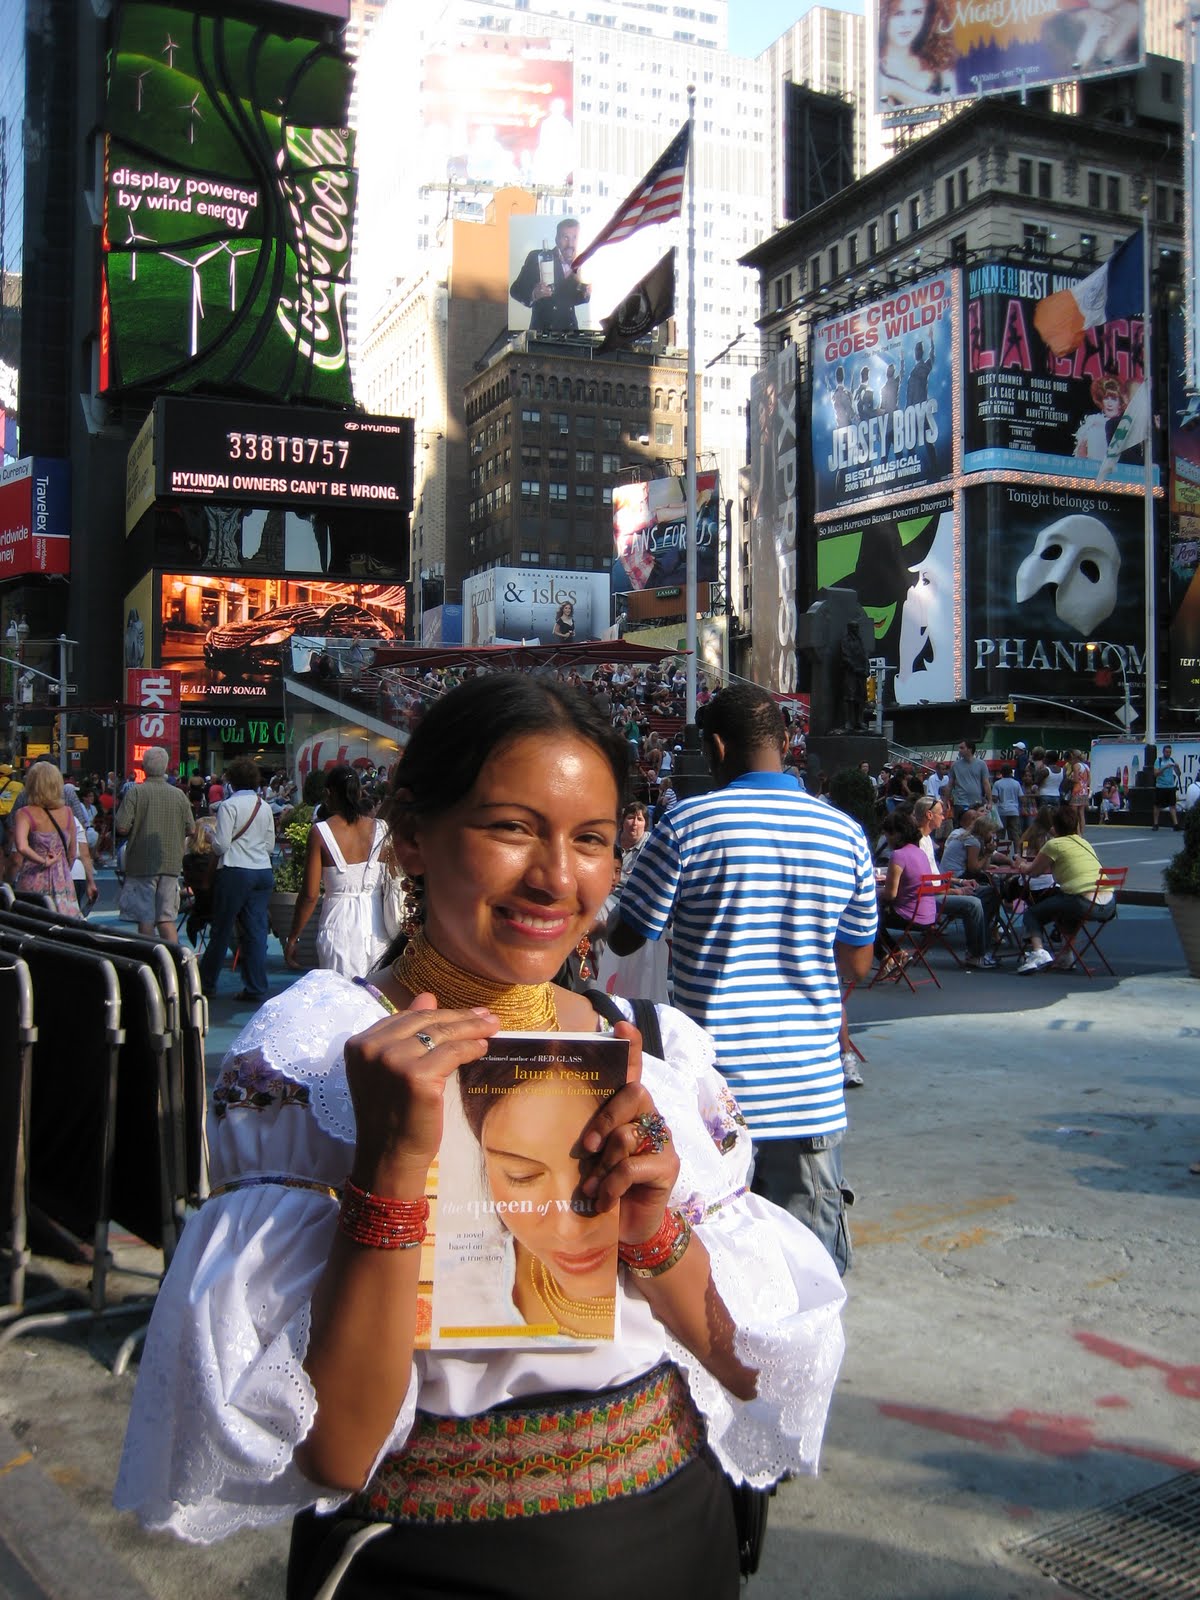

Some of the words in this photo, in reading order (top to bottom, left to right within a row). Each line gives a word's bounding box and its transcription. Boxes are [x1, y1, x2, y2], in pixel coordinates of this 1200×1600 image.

[112, 168, 181, 194] display
[186, 179, 258, 208] powered
[118, 189, 142, 212] by
[146, 194, 192, 213] wind
[196, 201, 249, 231] energy
[969, 265, 1018, 292] WINNER!
[1019, 269, 1048, 299] BEST
[866, 280, 945, 327] CROWD
[824, 327, 879, 363] GOES
[968, 300, 1032, 374] LA
[989, 386, 998, 398] LA
[1000, 386, 1015, 400] CAGE
[1017, 389, 1029, 402] AUX
[1031, 391, 1053, 405] FOLLES
[361, 424, 400, 434] HYUNDAI
[828, 413, 889, 472] JERSEY
[893, 399, 938, 454] BOYS
[229, 434, 349, 469] 33819757
[2, 463, 29, 480] Currency
[844, 467, 871, 483] BEST
[873, 454, 921, 476] MUSICAL
[859, 477, 874, 489] TONY
[897, 464, 921, 478] WINNER
[172, 471, 229, 489] HYUNDAI
[233, 475, 288, 493] OWNERS
[290, 479, 328, 495] CAN'T
[330, 482, 347, 497] BE
[350, 484, 400, 500] WRONG.
[36, 476, 49, 531] Travelex
[1006, 488, 1050, 508] Tonight
[1053, 492, 1095, 513] belongs
[777, 341, 798, 694] EXPRESS
[663, 523, 687, 550] FOR
[504, 582, 526, 603] &
[532, 579, 577, 606] isles
[974, 638, 1147, 675] PHANTOM
[1179, 658, 1196, 667] TEXT
[190, 685, 232, 695] ALL-NEW
[232, 685, 267, 696] SONATA
[1183, 754, 1200, 774] IT'
[538, 1055, 555, 1063] RED
[556, 1055, 582, 1063] GLASS
[514, 1065, 553, 1080] laura
[560, 1069, 600, 1081] resau
[468, 1084, 488, 1095] and
[567, 1085, 616, 1098] farinango
[442, 1201, 464, 1215] the
[466, 1199, 534, 1219] queen
[537, 1199, 552, 1216] of
[448, 1243, 472, 1251] based
[463, 1230, 484, 1239] novel
[467, 1254, 483, 1262] true
[484, 1254, 503, 1263] story
